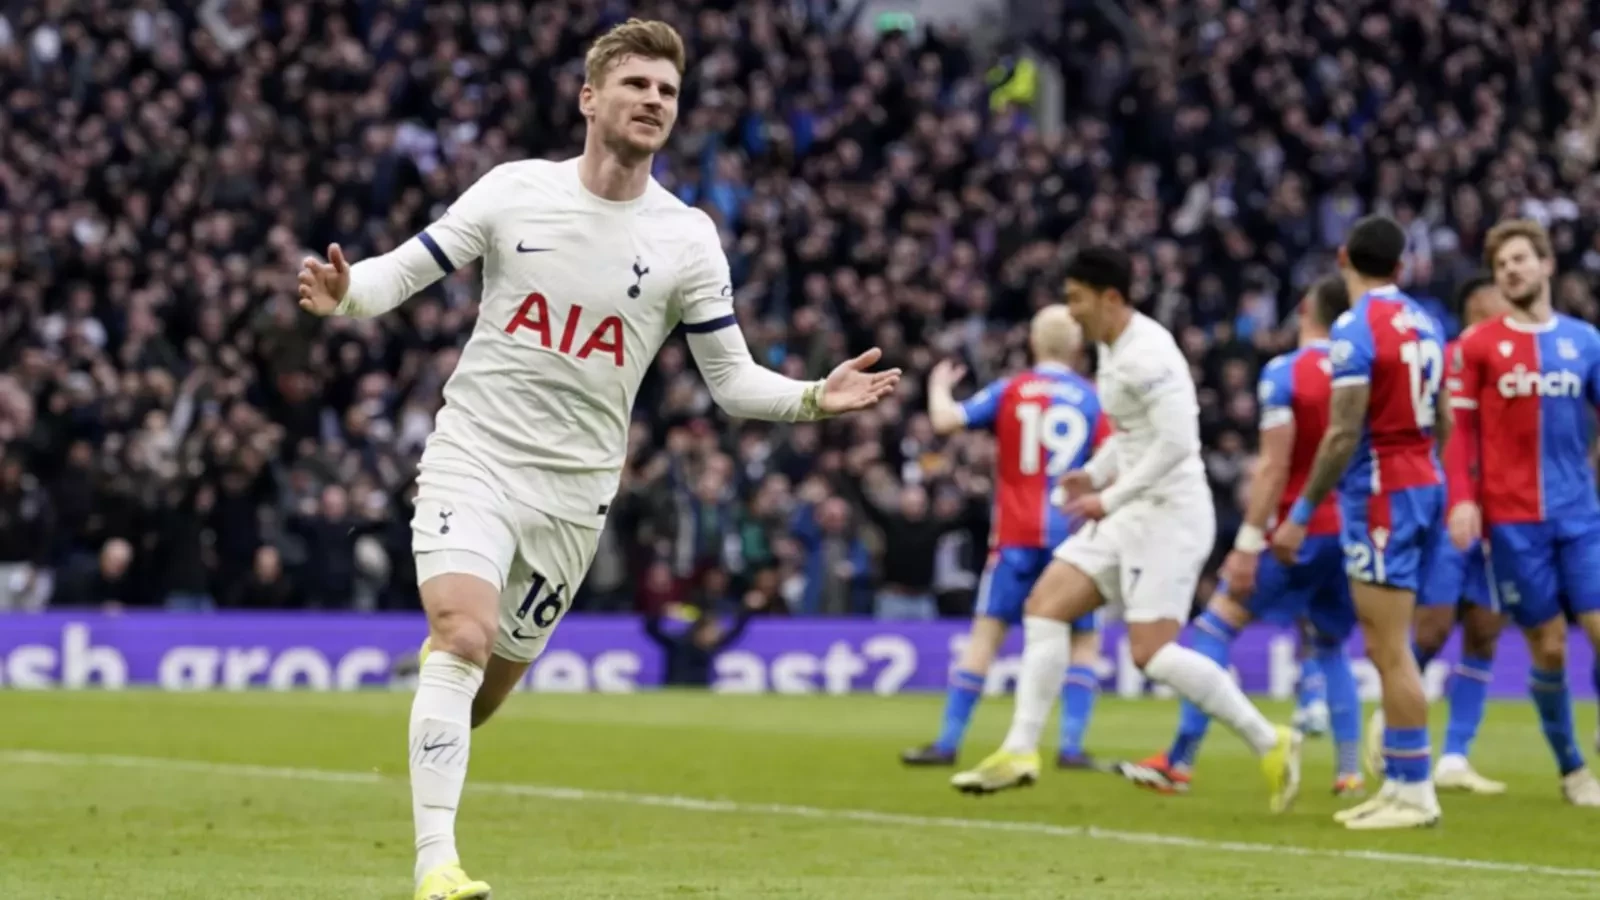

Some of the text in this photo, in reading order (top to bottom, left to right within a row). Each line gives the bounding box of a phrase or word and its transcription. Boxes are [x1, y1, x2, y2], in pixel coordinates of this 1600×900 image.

[504, 292, 624, 367] AIA
[1400, 338, 1444, 427] 12
[1498, 363, 1581, 399] cinch
[1016, 402, 1088, 476] 19
[516, 571, 566, 628] 16
[713, 636, 917, 694] ast?
